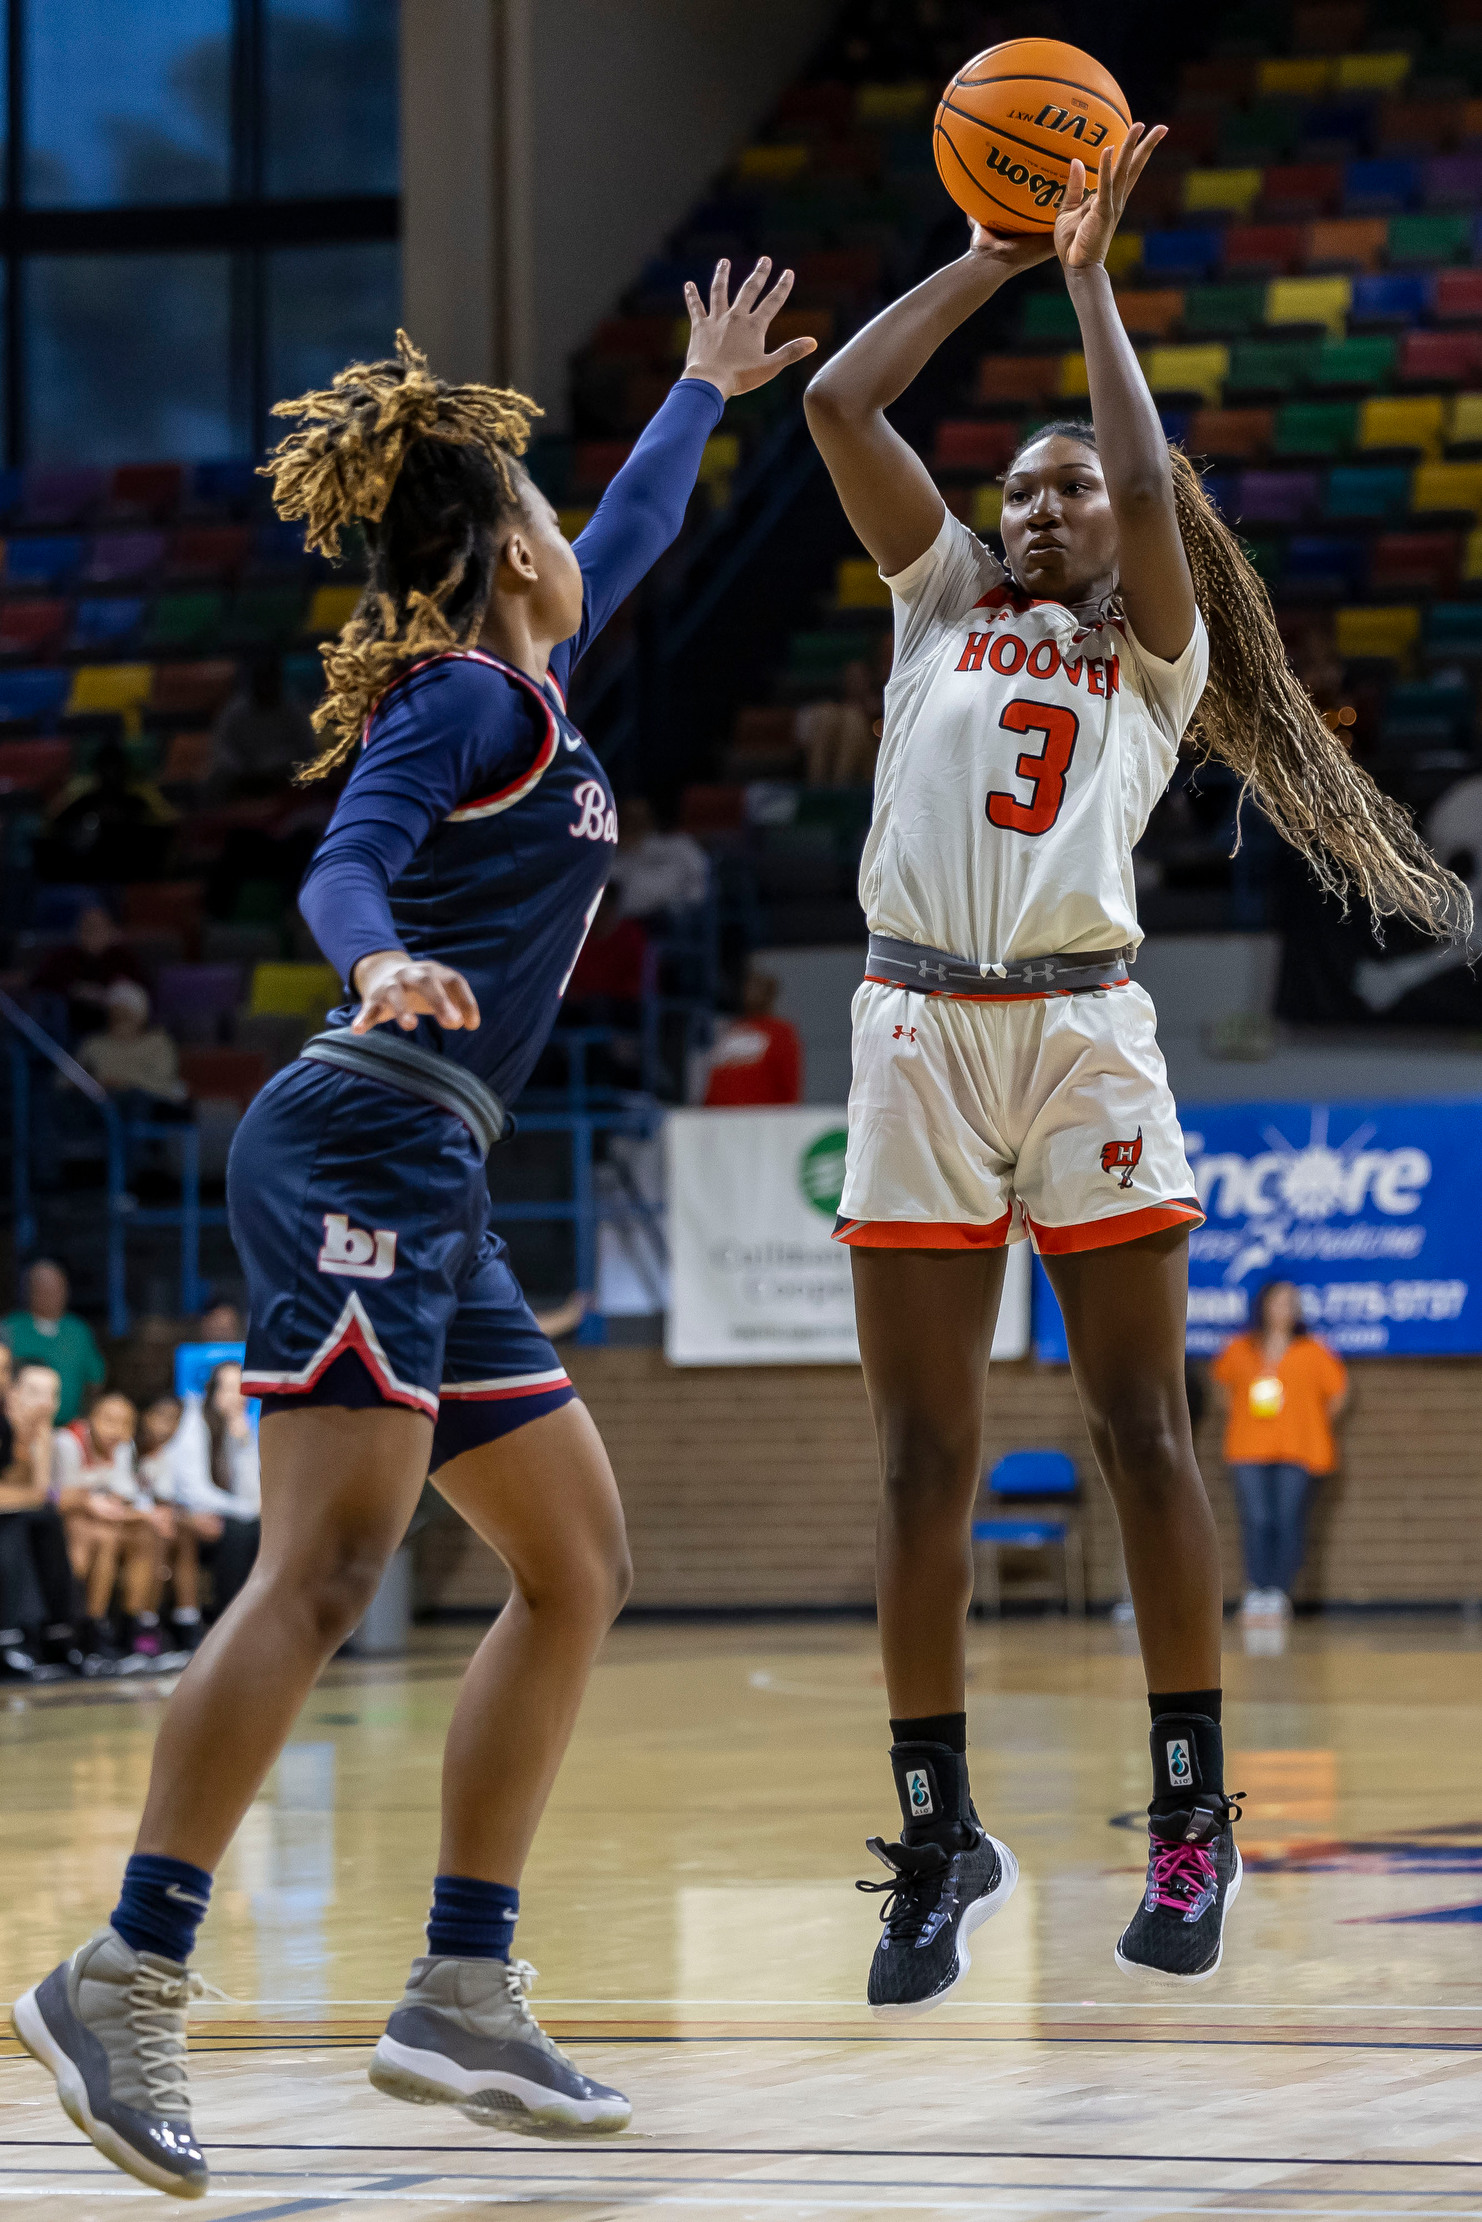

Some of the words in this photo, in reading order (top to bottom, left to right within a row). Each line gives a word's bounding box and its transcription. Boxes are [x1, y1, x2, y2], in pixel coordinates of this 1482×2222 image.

[1006, 108, 1034, 123] NXT
[1034, 104, 1109, 148] EVO
[985, 698, 1080, 837] 3
[1115, 1143, 1136, 1164] H
